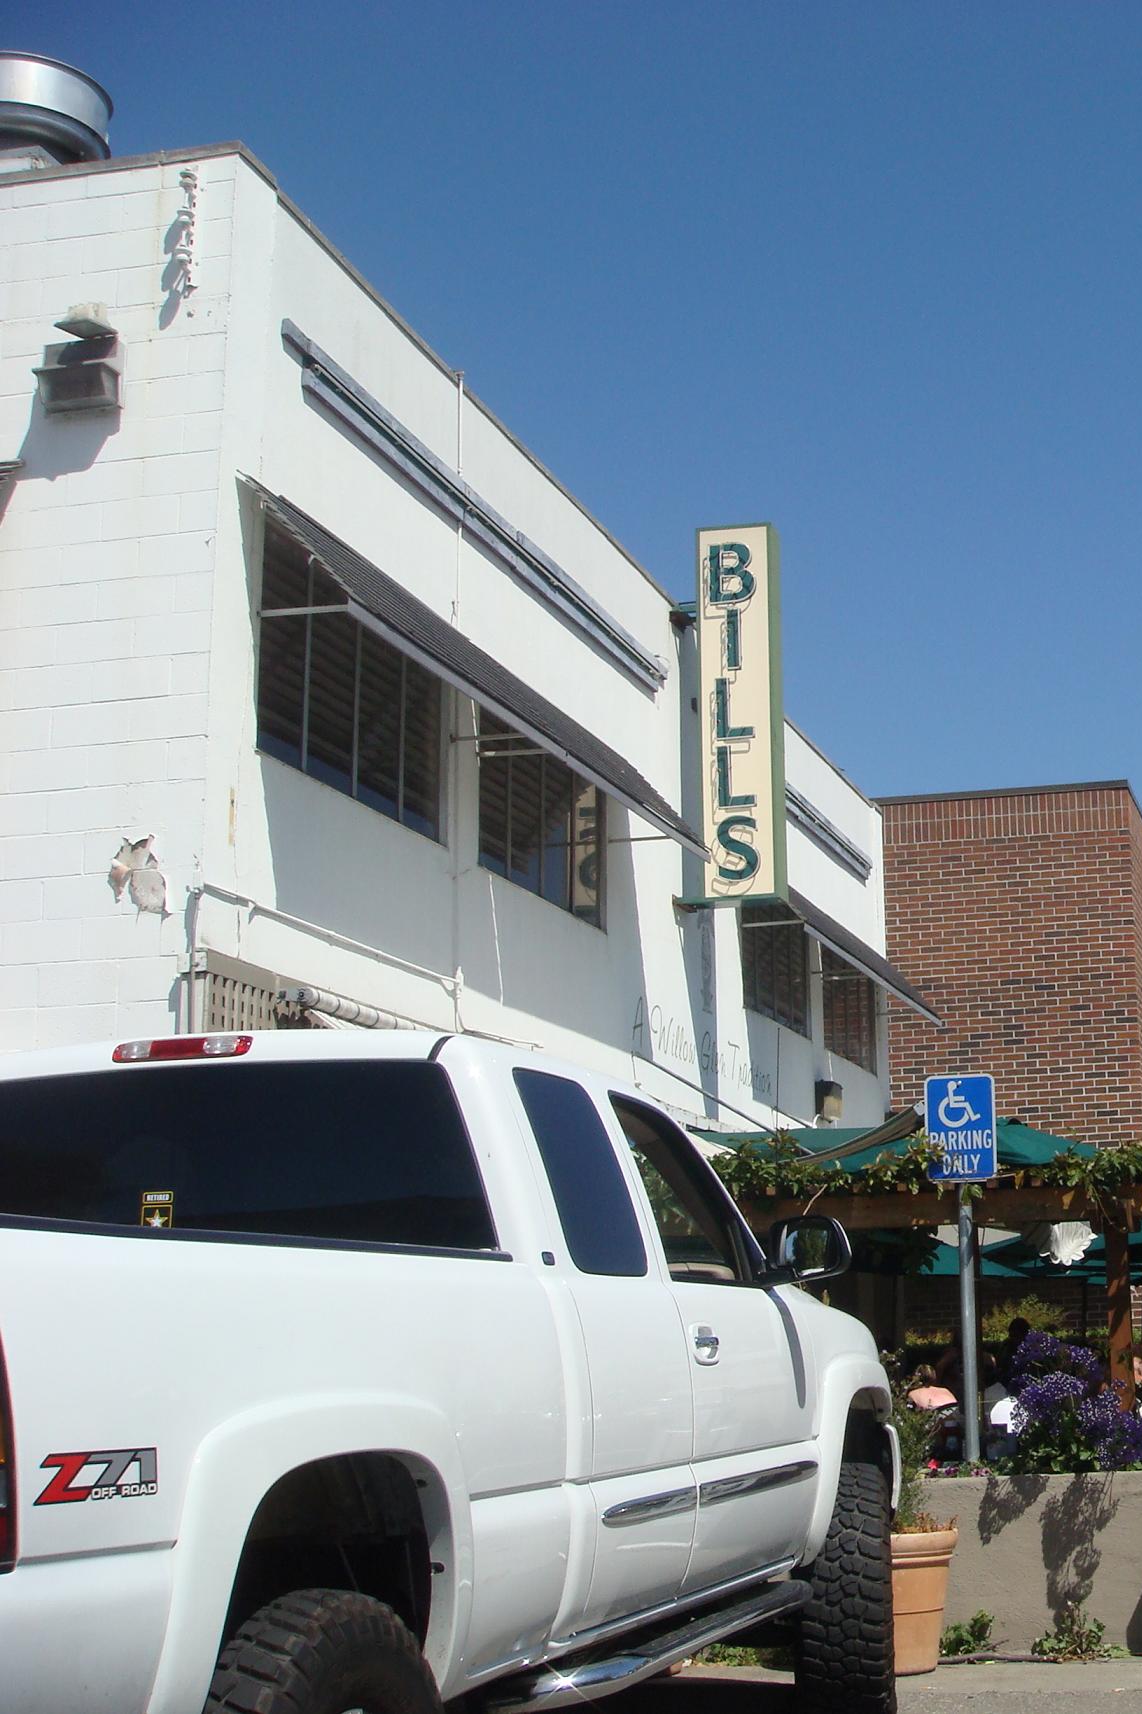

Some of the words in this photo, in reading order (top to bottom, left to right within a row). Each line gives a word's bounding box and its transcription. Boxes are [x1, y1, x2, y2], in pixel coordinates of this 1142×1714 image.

[706, 541, 760, 884] BILLS
[632, 996, 645, 1048] A
[651, 1004, 698, 1066] Willow
[930, 1129, 992, 1151] PARKING
[942, 1154, 980, 1175] ONLY
[33, 1447, 158, 1506] Z71
[91, 1486, 117, 1500] OFF
[121, 1482, 157, 1498] ROAD
